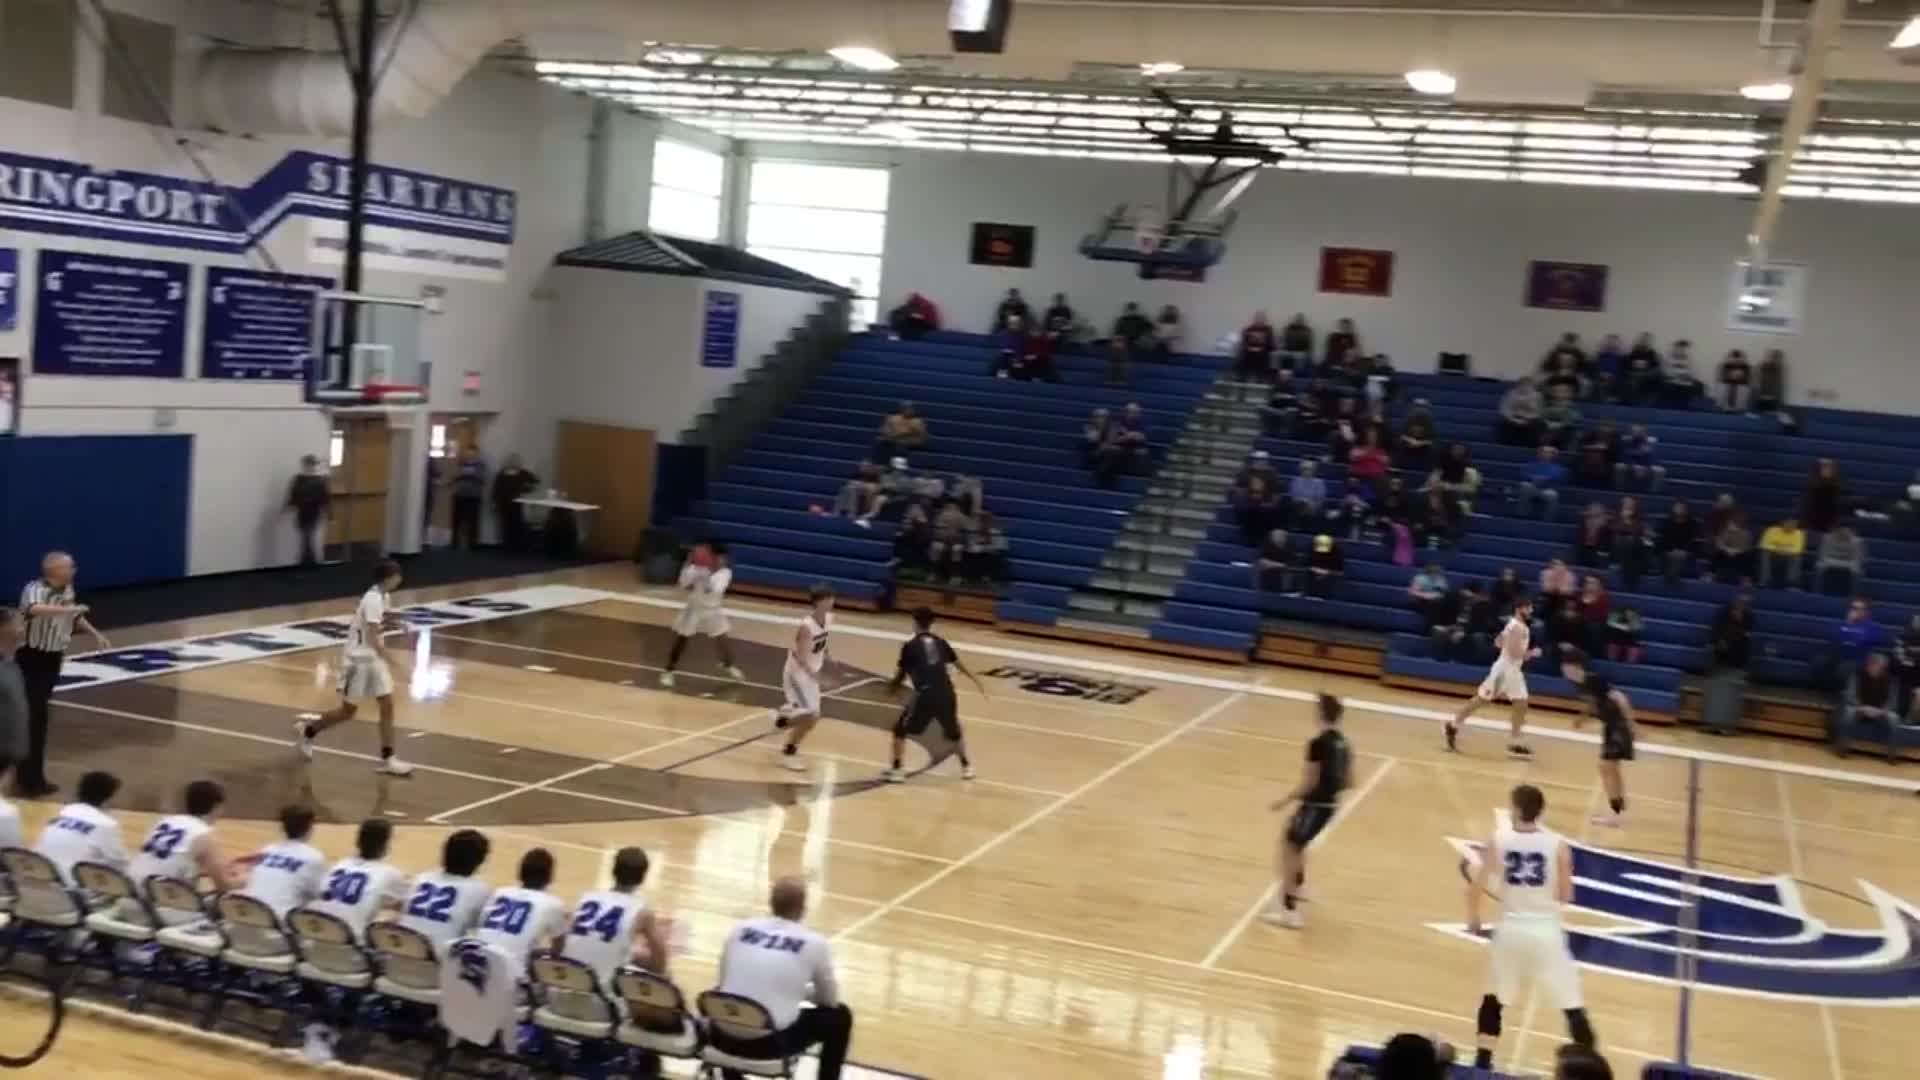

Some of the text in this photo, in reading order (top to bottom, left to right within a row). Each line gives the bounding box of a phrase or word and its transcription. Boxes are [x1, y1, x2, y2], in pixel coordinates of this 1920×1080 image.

[1505, 851, 1545, 887] 23
[407, 882, 458, 923] 22
[483, 895, 533, 936] 20
[570, 900, 625, 943] 24
